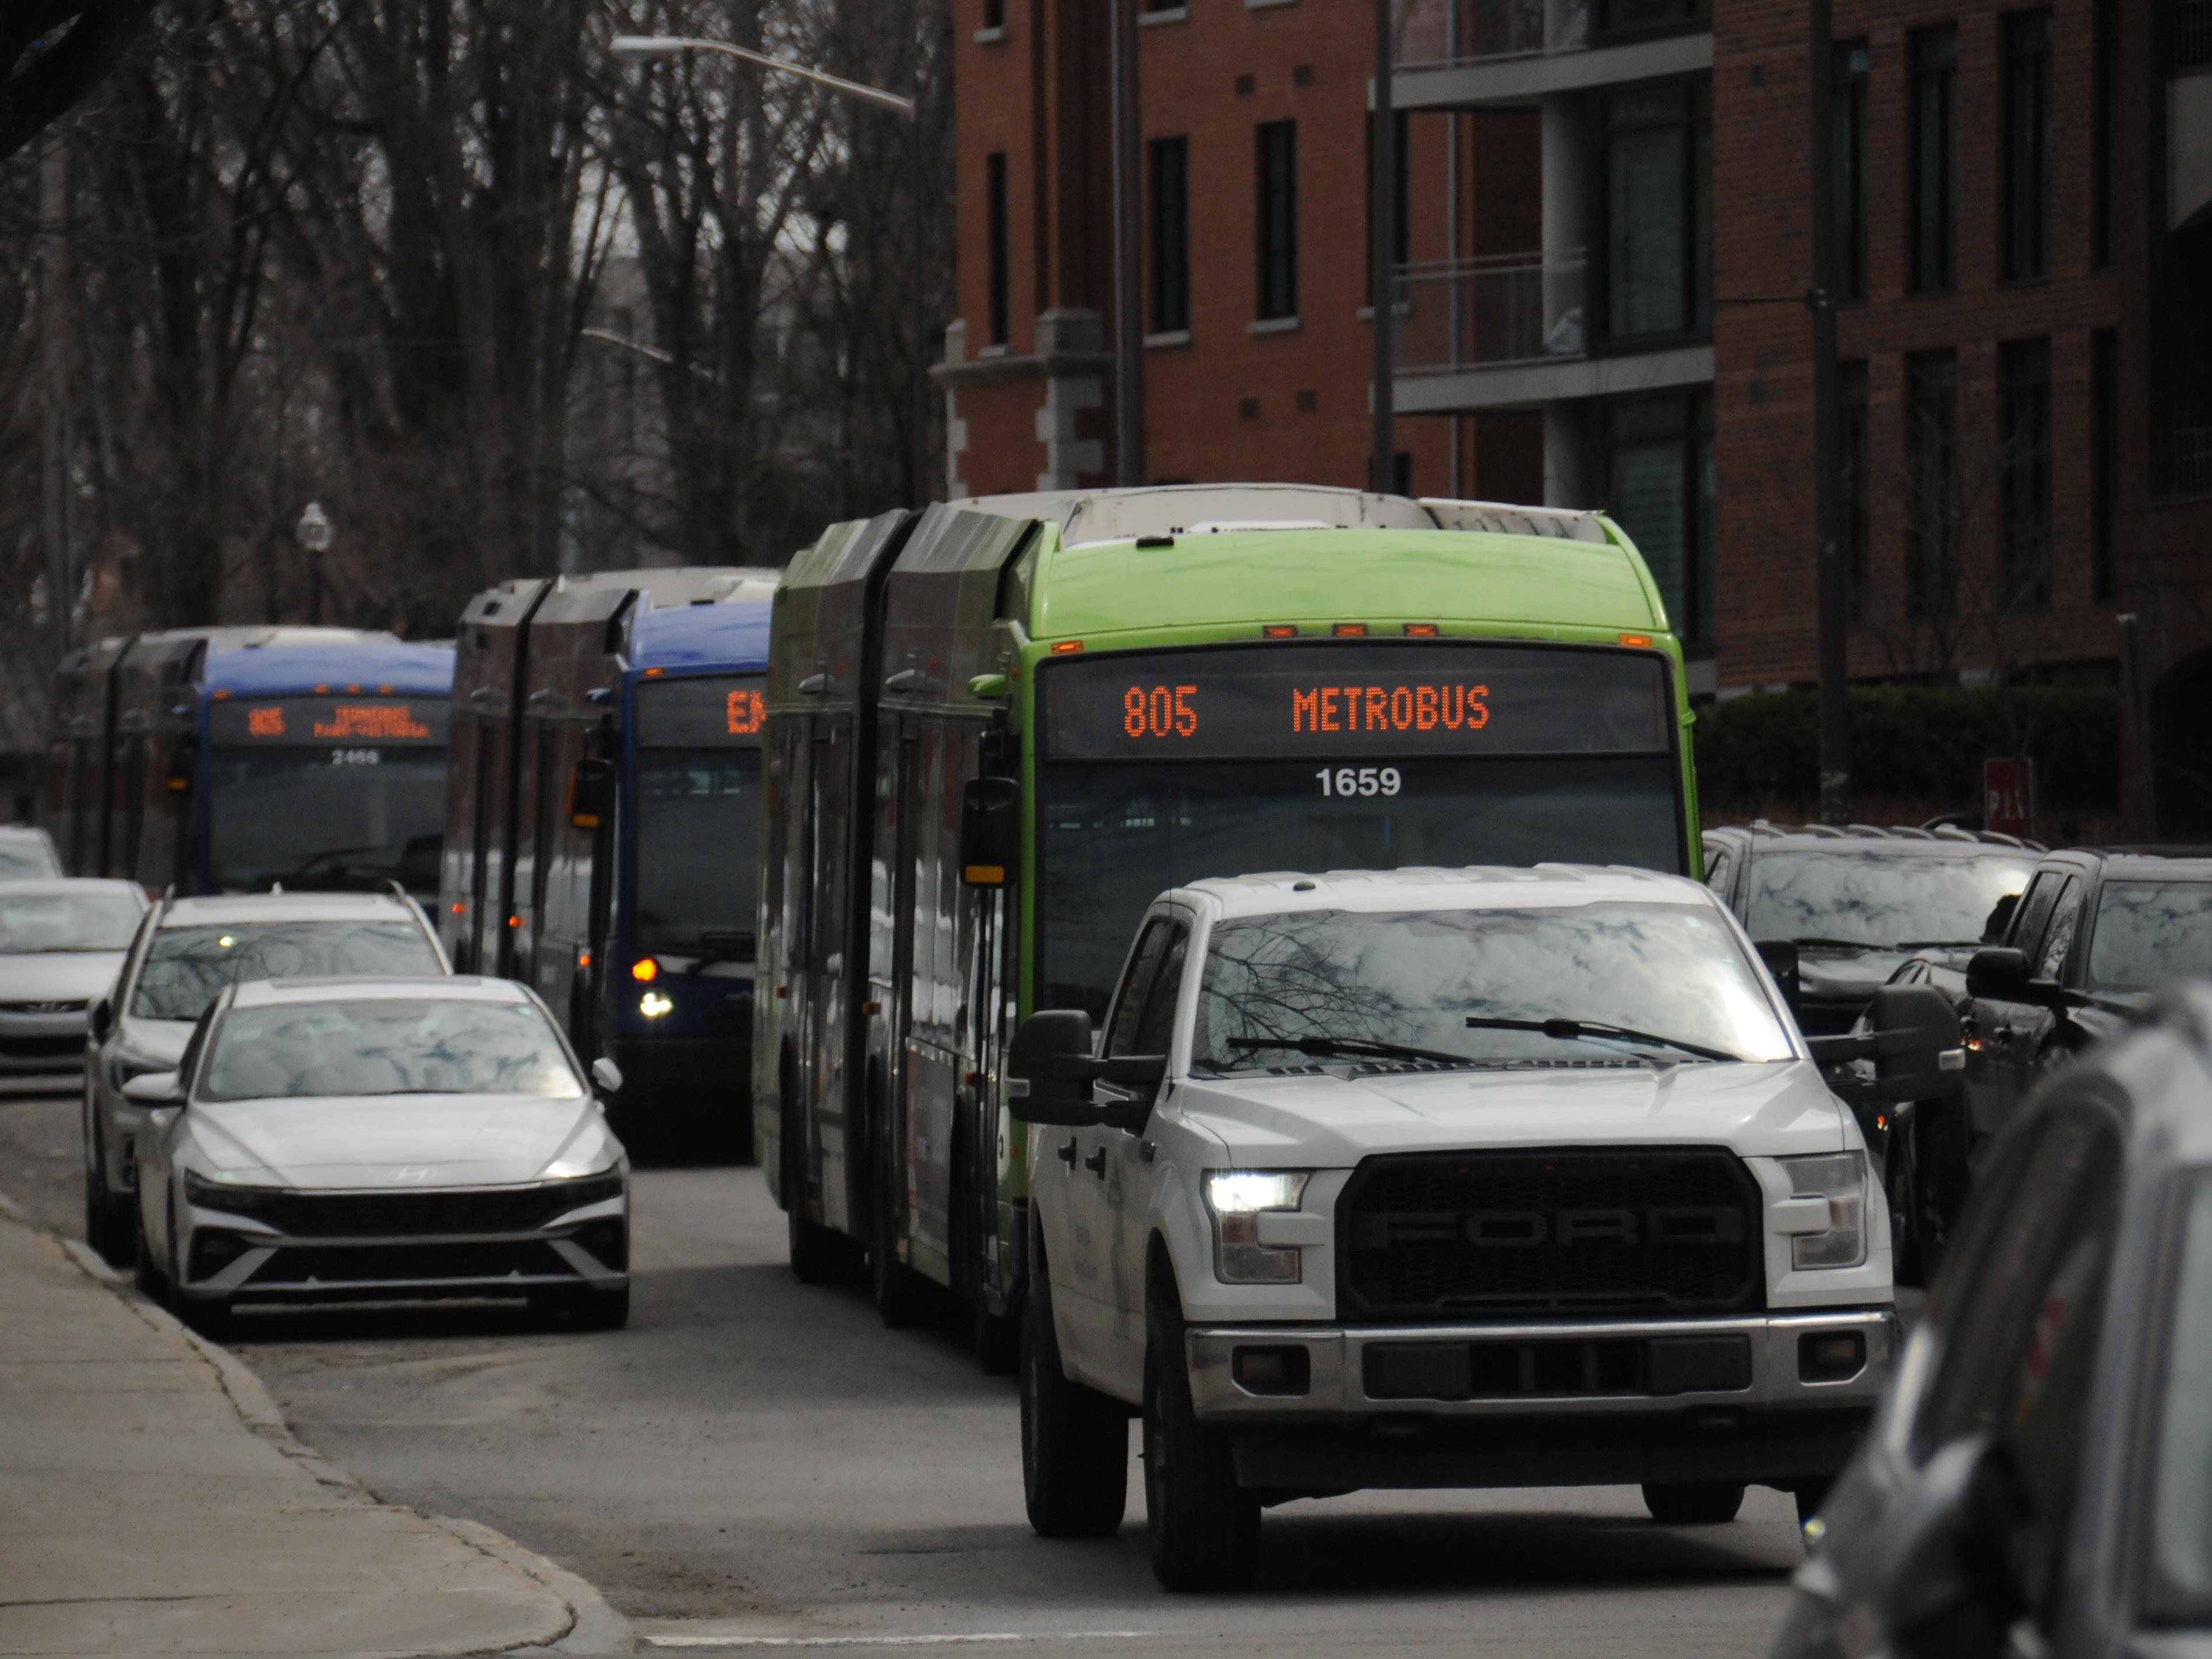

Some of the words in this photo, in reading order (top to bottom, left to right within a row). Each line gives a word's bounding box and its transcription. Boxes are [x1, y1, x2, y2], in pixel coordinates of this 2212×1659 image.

[1124, 685, 1198, 737] 805
[1292, 684, 1490, 732] METROBUS
[1315, 767, 1402, 797] 1659
[1353, 1208, 1744, 1248] FORD
